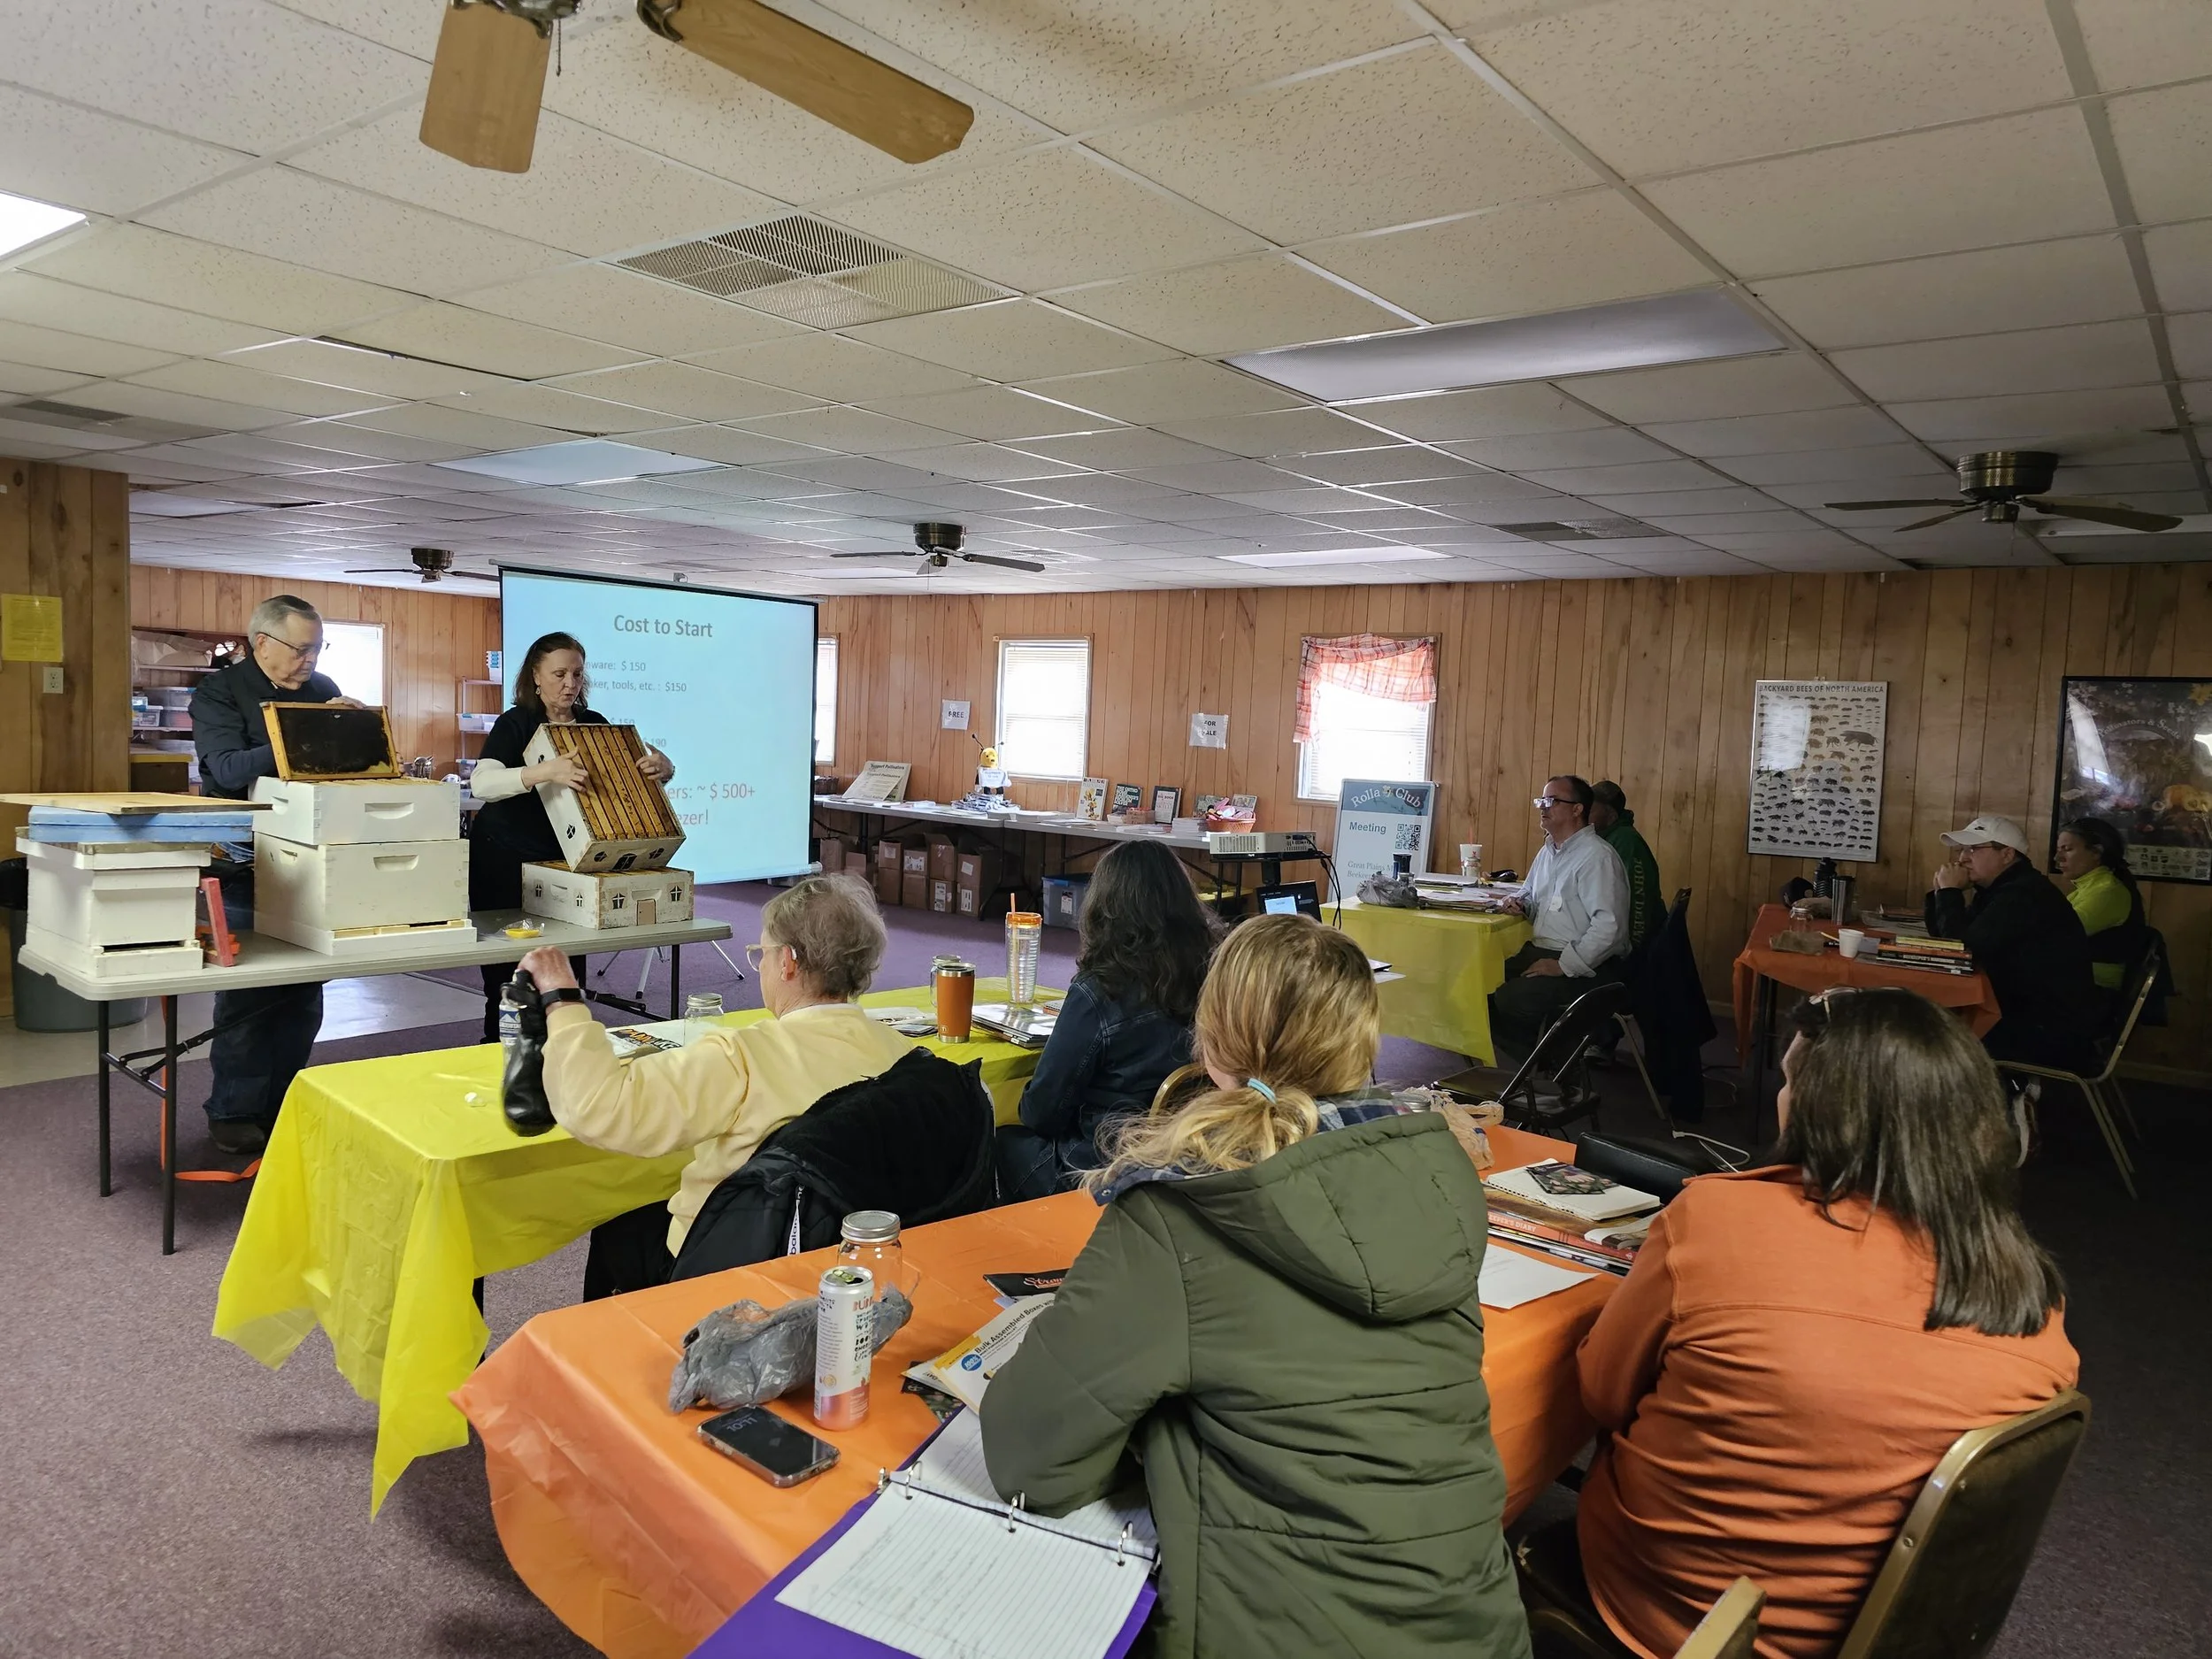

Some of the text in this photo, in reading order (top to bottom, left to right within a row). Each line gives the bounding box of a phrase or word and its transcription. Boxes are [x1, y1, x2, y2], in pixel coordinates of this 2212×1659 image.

[614, 614, 713, 637] Cost to Start
[621, 661, 627, 672] $
[629, 662, 646, 672] 150
[612, 680, 636, 691] tools,
[665, 682, 687, 692] $150
[722, 783, 756, 799] 500+
[1350, 787, 1421, 808] Rolla Club
[1349, 821, 1386, 835] Meeting
[1366, 862, 1386, 871] Plains
[1633, 857, 1645, 895] JOHN
[1515, 1221, 1537, 1233] DIARY
[974, 1340, 990, 1354] Bulk
[990, 1313, 1025, 1342] Assembled
[1024, 1303, 1044, 1316] Boxes
[726, 1417, 758, 1432] 10:11
